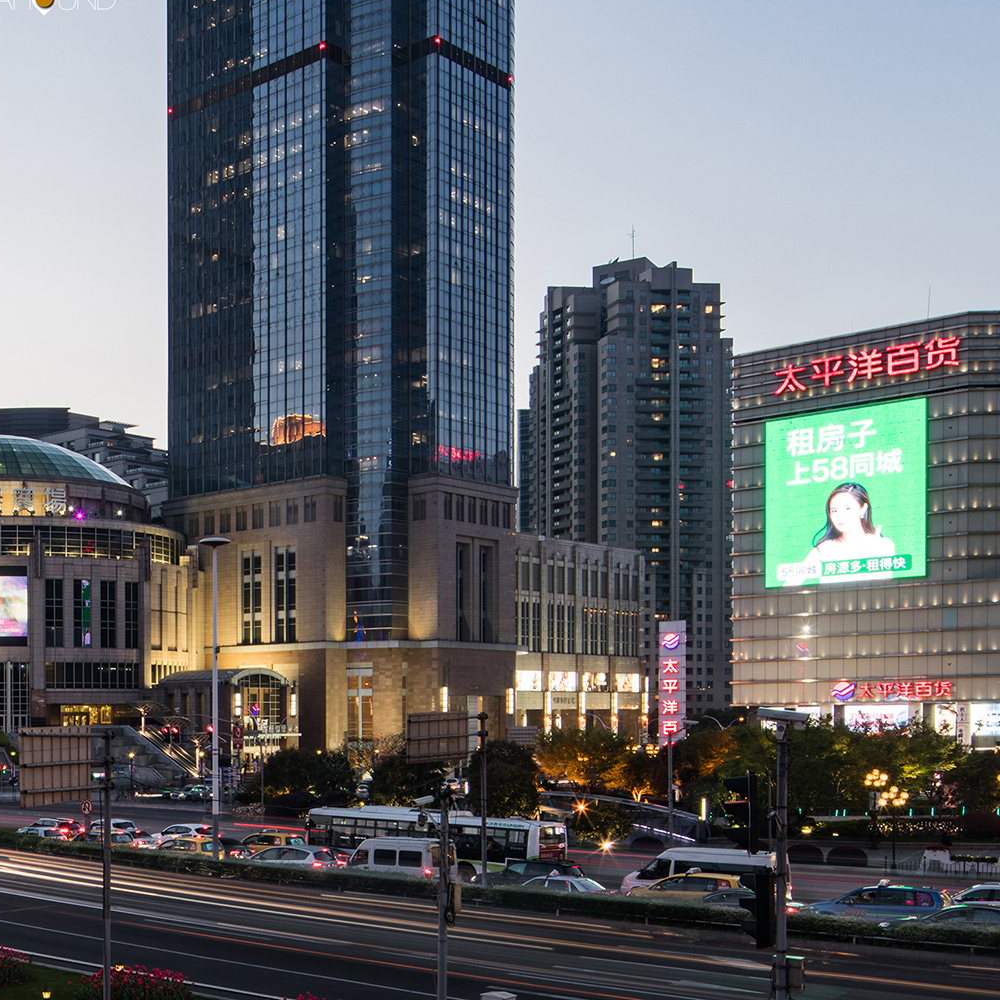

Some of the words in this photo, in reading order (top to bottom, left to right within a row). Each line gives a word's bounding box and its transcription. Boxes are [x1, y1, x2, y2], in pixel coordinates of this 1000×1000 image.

[774, 335, 961, 396] 太平洋百货
[786, 419, 877, 457] 租房子
[786, 447, 904, 486] 上58同城
[662, 658, 679, 747] 太平洋百
[857, 680, 953, 698] 太平洋百货
